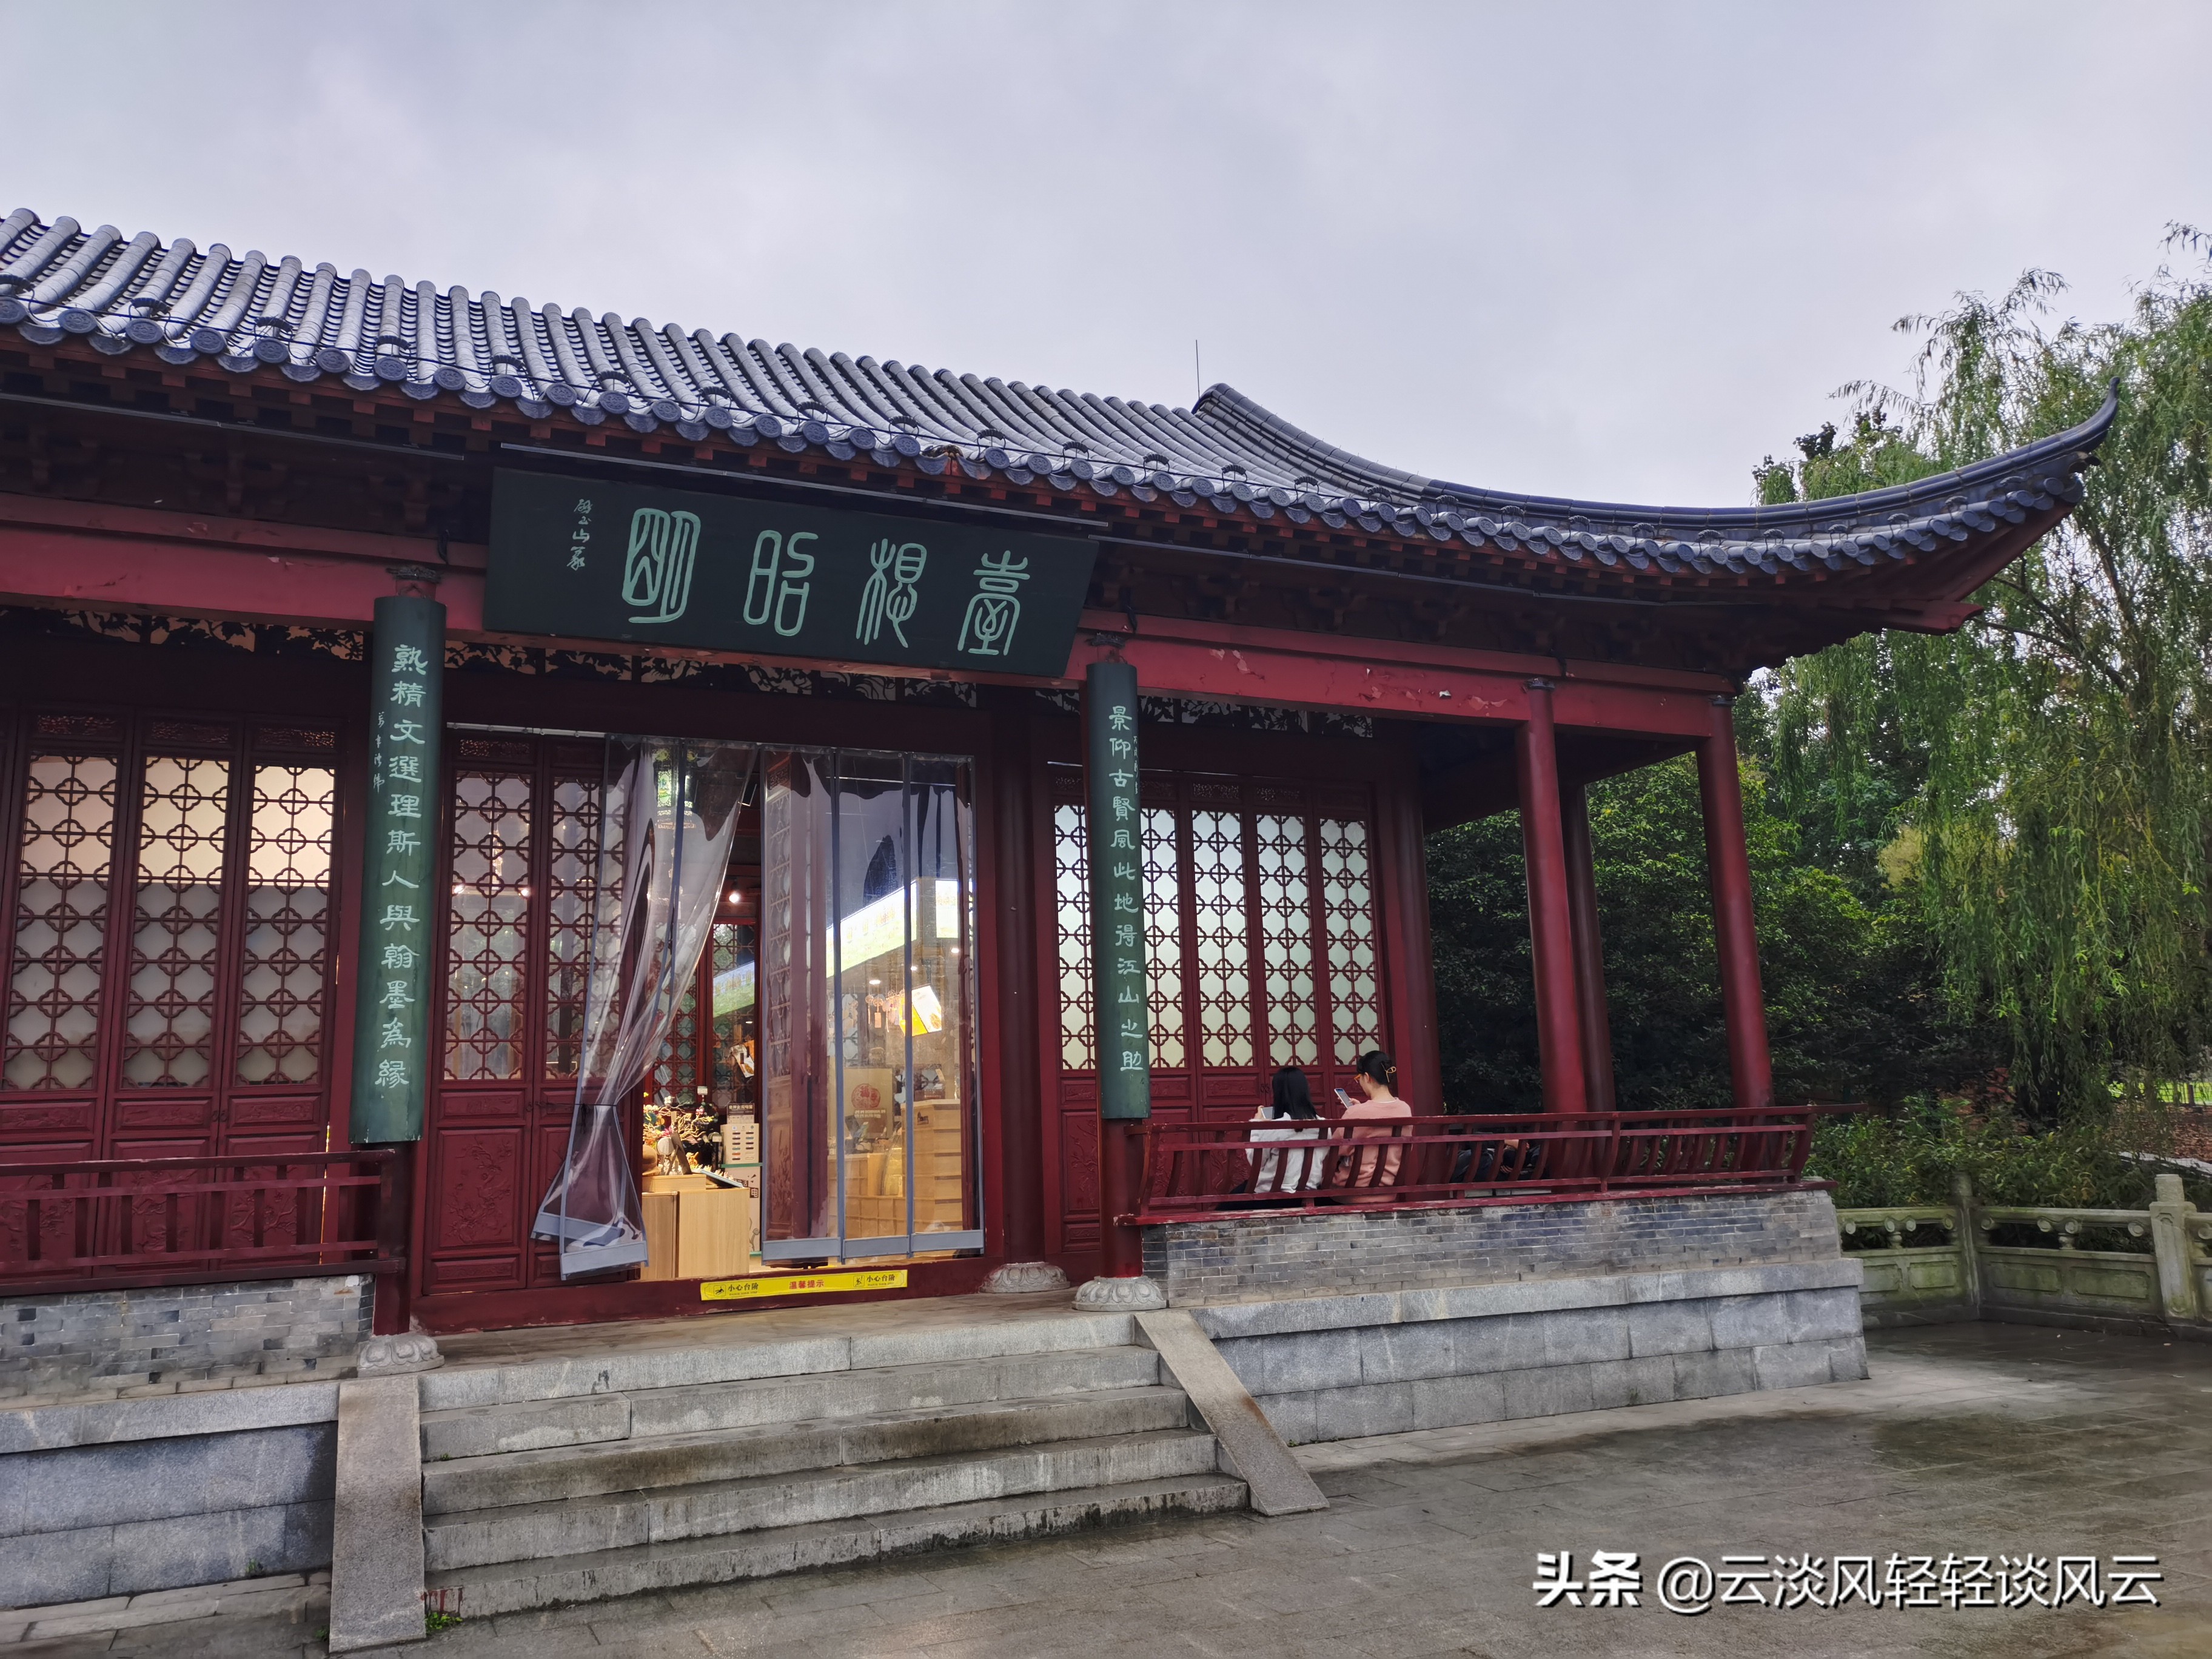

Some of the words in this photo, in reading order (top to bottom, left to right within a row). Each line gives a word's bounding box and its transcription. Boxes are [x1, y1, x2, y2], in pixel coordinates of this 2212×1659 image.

[866, 1273, 895, 1282] 小心台阶
[728, 1282, 759, 1292] 小心台阶
[789, 1279, 824, 1289] 温馨提示
